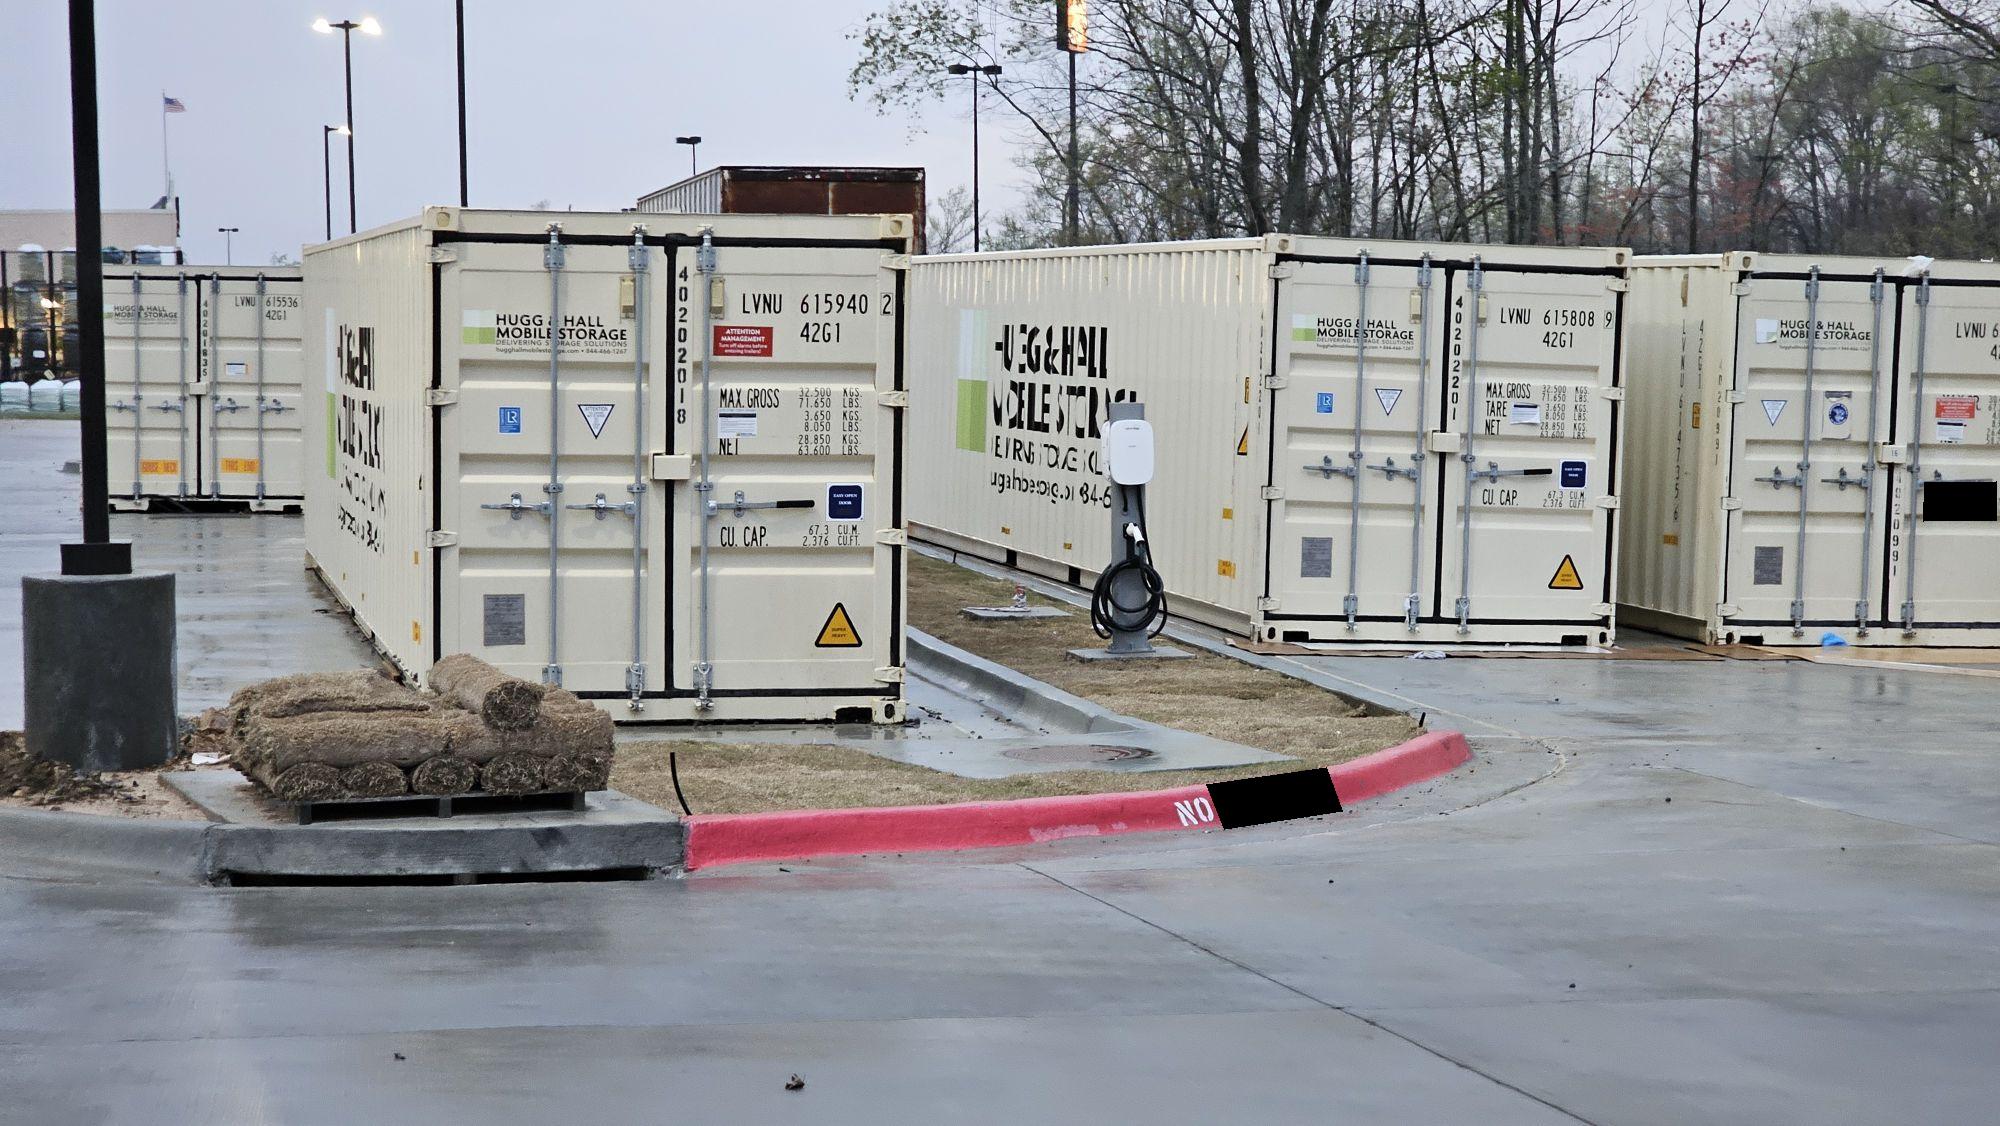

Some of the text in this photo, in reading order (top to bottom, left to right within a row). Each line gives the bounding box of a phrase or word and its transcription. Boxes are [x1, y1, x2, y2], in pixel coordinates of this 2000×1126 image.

[235, 296, 298, 309] LVNU 615536
[742, 293, 892, 314] LVNU 615940 2
[265, 310, 287, 321] 42G1
[496, 314, 543, 326] HUGG
[564, 315, 604, 328] HALL
[1500, 307, 1613, 328] LVNU 615808 9
[1317, 318, 1352, 327] HUGG
[1367, 320, 1397, 330] HALL
[1816, 321, 1824, 330] &
[1827, 321, 1855, 331] HALL
[1956, 321, 1987, 339] LVNU
[496, 327, 628, 341] MOBILE STORAGE
[800, 322, 841, 343] 42G1
[1317, 328, 1414, 340] MOBILE STORAGE
[1542, 331, 1574, 348] 42G1
[1780, 330, 1871, 341] MOBIE STORAGE
[1061, 326, 1108, 379] HALL
[1990, 344, 2000, 360] 4
[747, 388, 780, 408] GROSS
[1506, 383, 1531, 399] GROSS
[1486, 401, 1507, 417] TARE
[1484, 420, 1501, 435] NET
[1482, 489, 1519, 506] CU. CAP.
[720, 526, 769, 546] CU. CAP.
[808, 525, 829, 535] 67.3
[1173, 797, 1214, 827] NO
